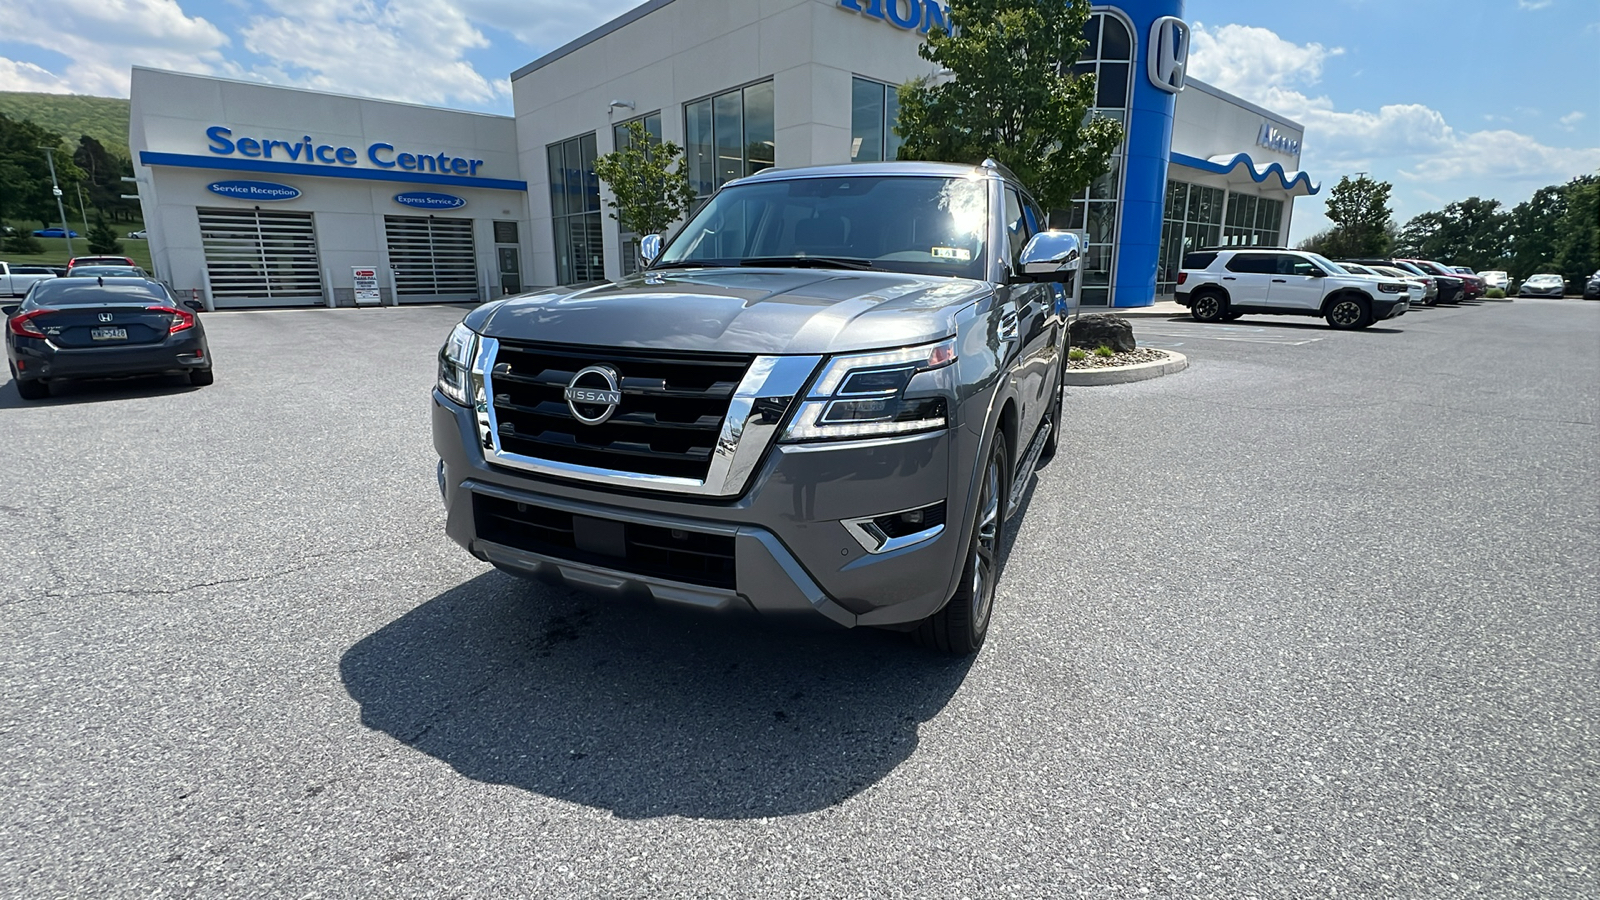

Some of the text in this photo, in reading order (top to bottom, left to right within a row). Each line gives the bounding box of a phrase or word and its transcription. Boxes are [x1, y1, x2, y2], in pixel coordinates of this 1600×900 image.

[206, 126, 484, 175] Service Center
[212, 184, 296, 196] Service Reception
[397, 195, 452, 205] Express Service
[565, 389, 619, 403] NISSAN
